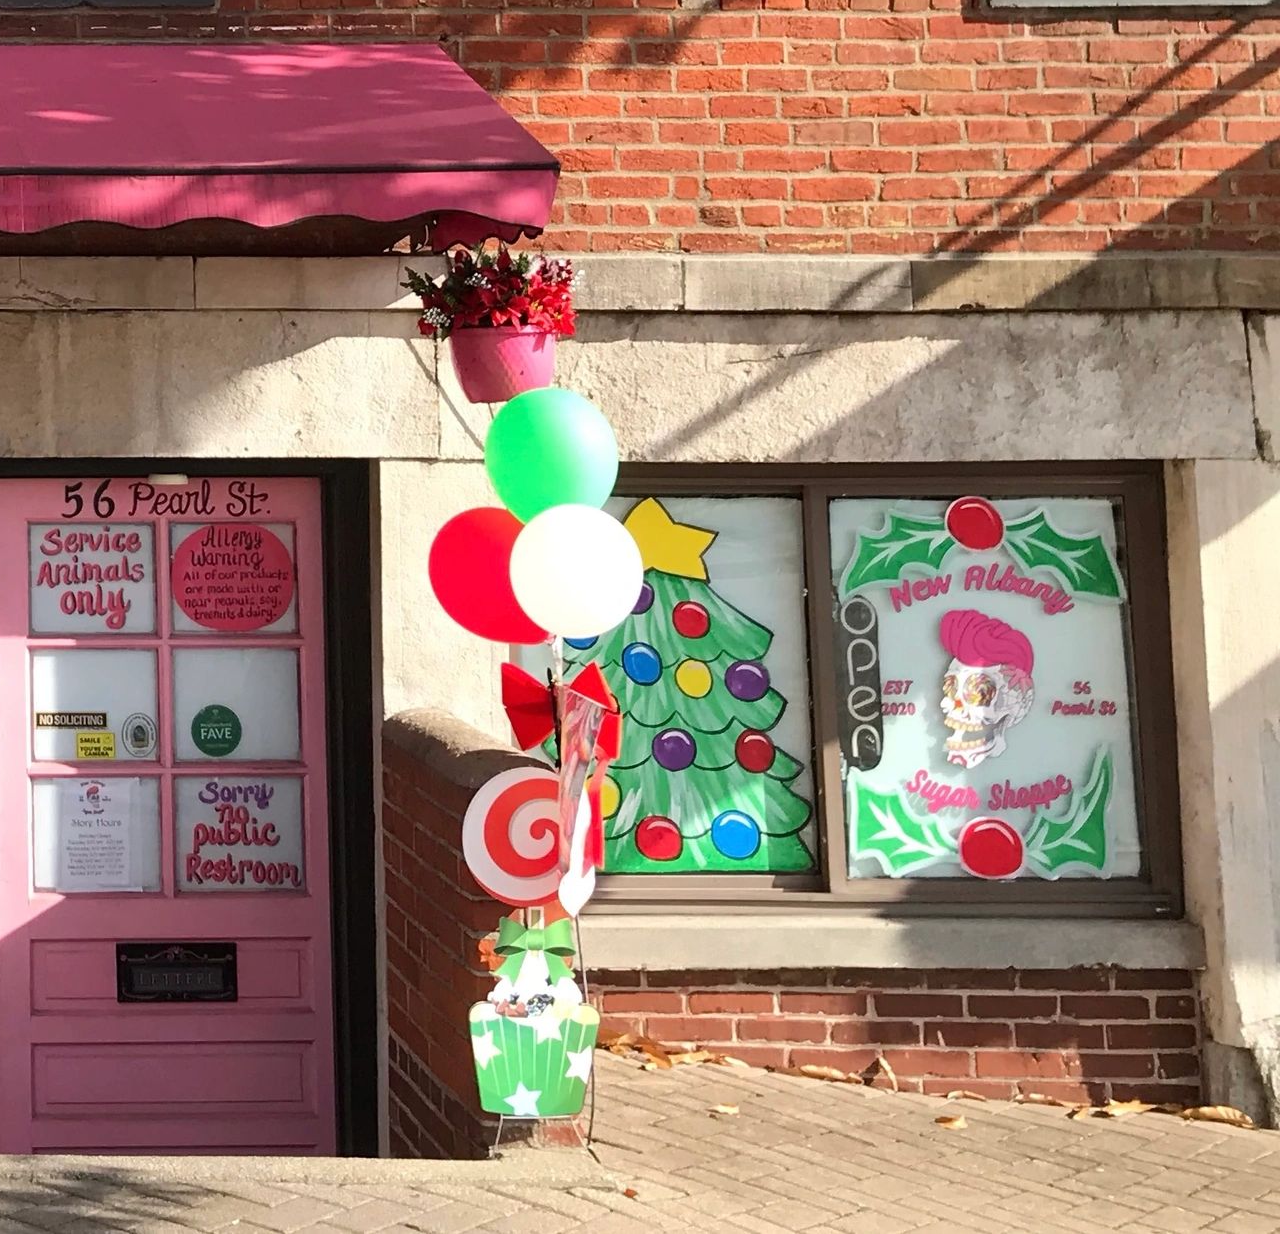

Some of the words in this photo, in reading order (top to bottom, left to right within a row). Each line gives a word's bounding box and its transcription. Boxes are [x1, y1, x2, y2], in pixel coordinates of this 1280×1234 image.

[61, 479, 115, 518] 56
[128, 479, 215, 516] Pearl
[226, 480, 271, 516] St.
[40, 526, 142, 556] Service
[201, 526, 263, 550] Allergy
[190, 548, 264, 570] Warning
[37, 555, 144, 588] Animals
[183, 571, 200, 581] All
[204, 570, 217, 580] of
[218, 571, 238, 580] our
[240, 568, 289, 581] products
[185, 586, 202, 595] are
[207, 584, 234, 594] made
[237, 584, 264, 594] with
[267, 585, 281, 594] or
[889, 574, 951, 613] New
[964, 562, 1075, 615] Albany
[60, 585, 131, 630] only
[184, 598, 211, 608] near
[883, 680, 913, 695] EST
[1073, 681, 1091, 695] 56
[881, 702, 916, 716] 2020
[1098, 700, 1117, 715] St
[39, 715, 54, 726] NO
[54, 714, 103, 726] SOLICITING
[200, 728, 232, 740] FAVE
[198, 782, 274, 809] Sorry
[906, 770, 980, 814] Sugar
[988, 773, 1071, 812] Shoppe
[215, 804, 250, 824] no
[193, 818, 280, 854] public
[186, 853, 302, 887] Restroom
